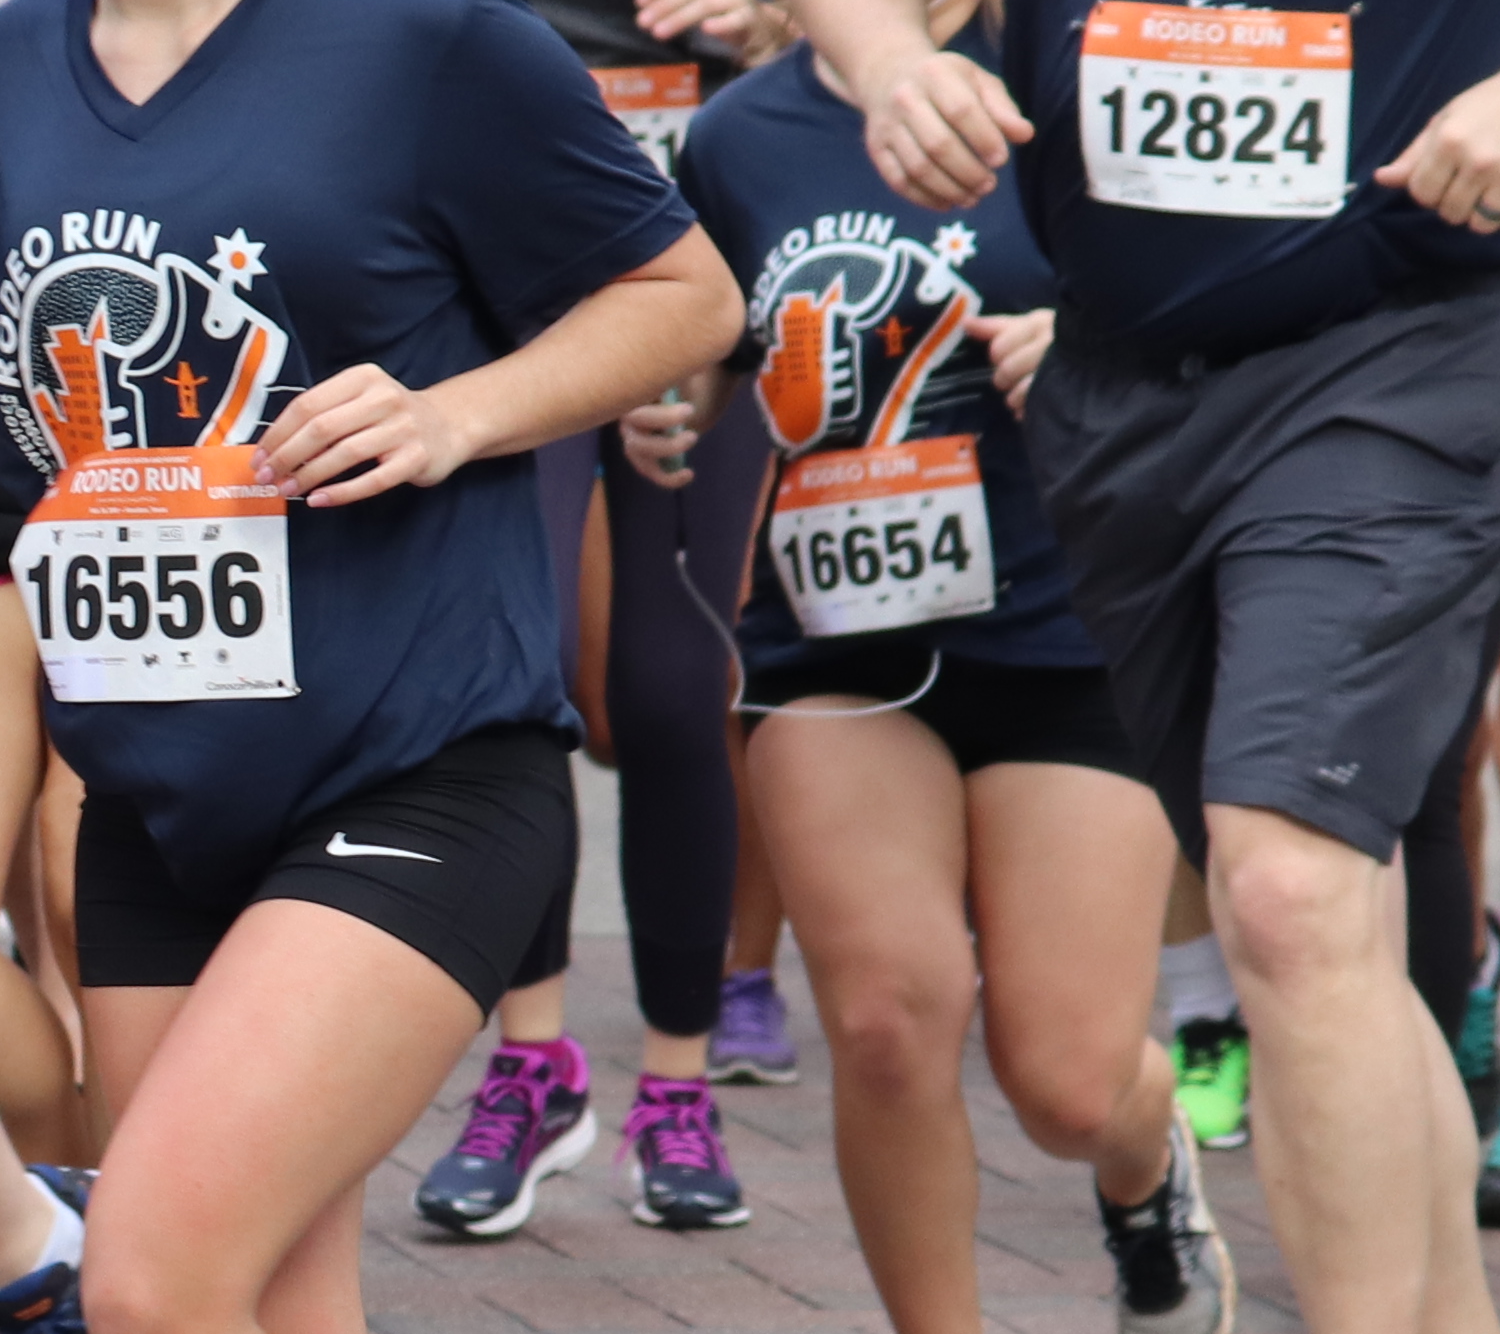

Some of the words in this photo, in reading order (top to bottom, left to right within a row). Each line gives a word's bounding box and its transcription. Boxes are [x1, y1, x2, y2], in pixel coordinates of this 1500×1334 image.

[1140, 17, 1227, 44] RODEO
[1231, 23, 1288, 47] RUN
[1099, 85, 1326, 165] 12824
[61, 208, 161, 261] RUN
[812, 210, 898, 247] RUN
[69, 467, 140, 496] RODEO
[144, 465, 203, 493] RUN
[803, 459, 864, 490] RODEO
[868, 451, 920, 480] RUN
[206, 484, 280, 500] UNTIMED
[783, 512, 972, 595] 16654
[25, 550, 265, 642] 16556
